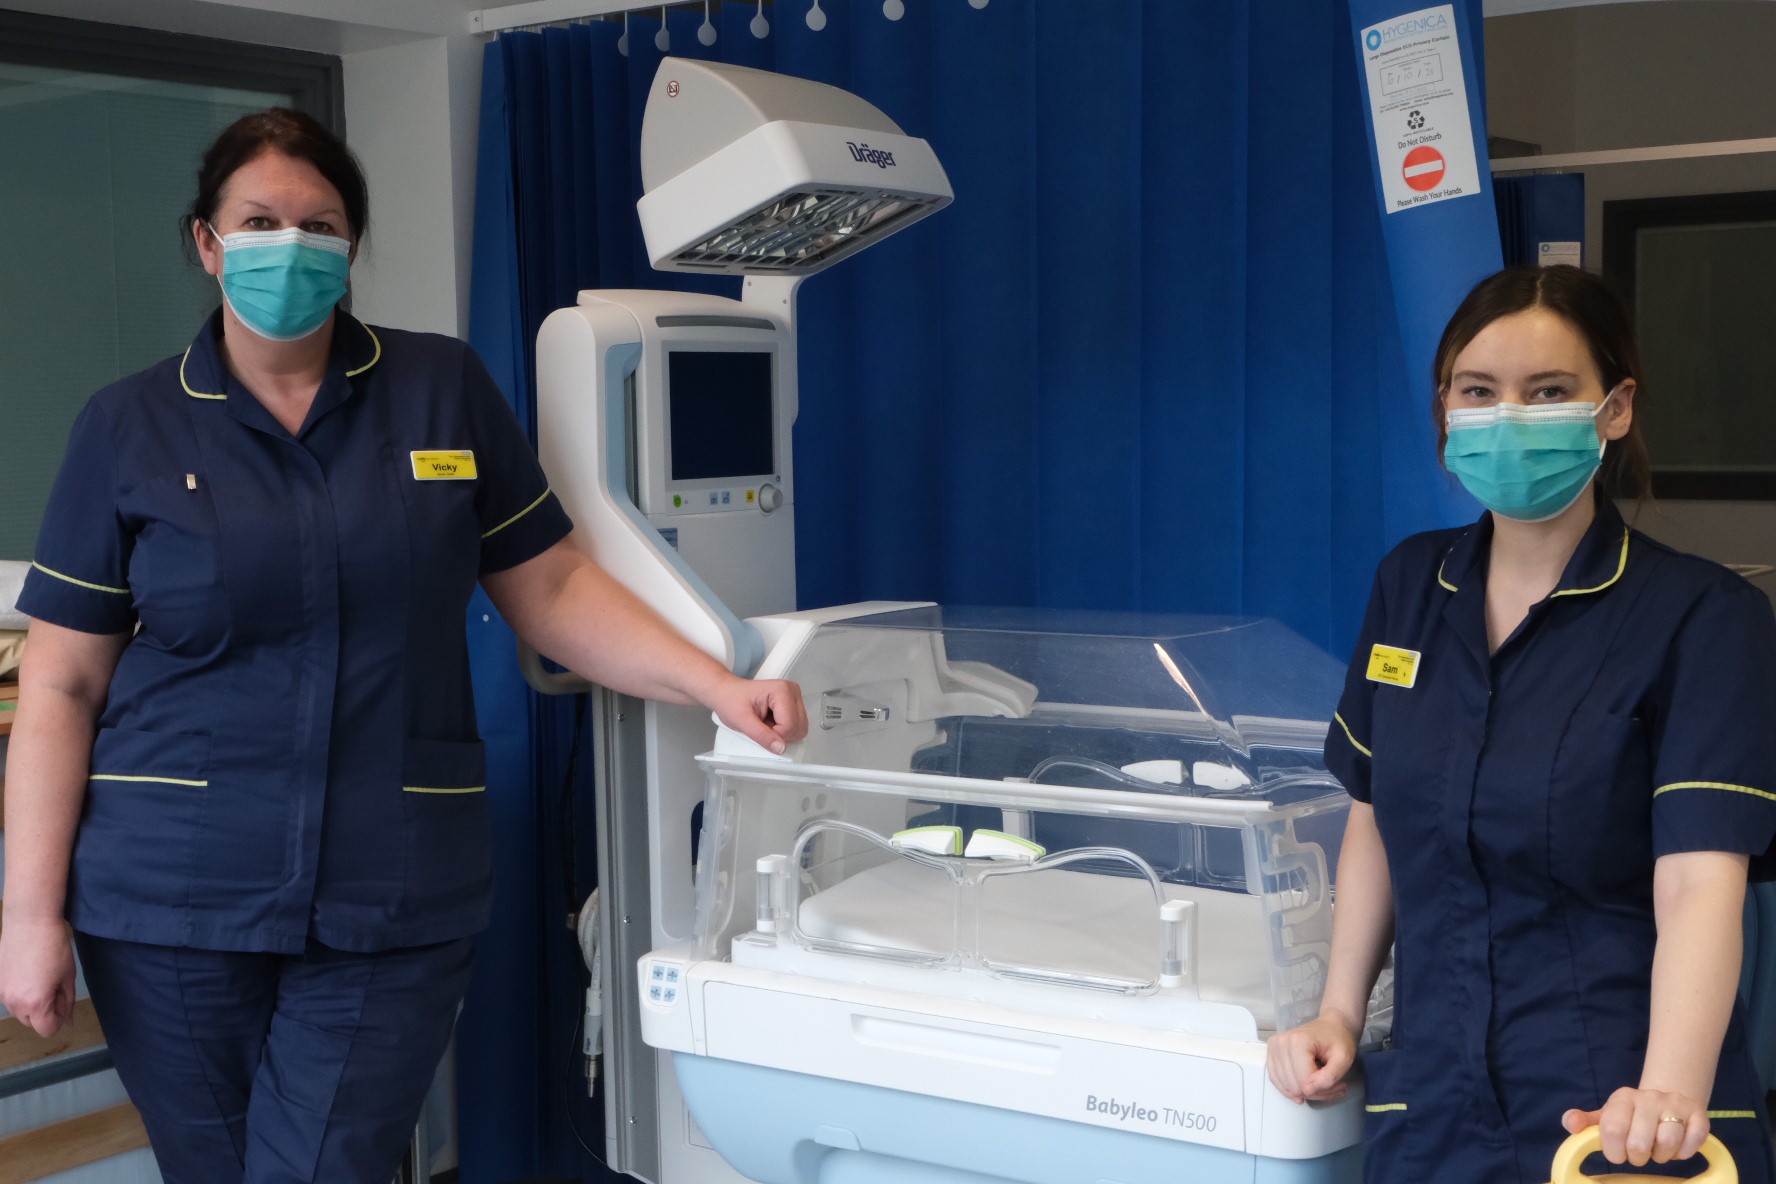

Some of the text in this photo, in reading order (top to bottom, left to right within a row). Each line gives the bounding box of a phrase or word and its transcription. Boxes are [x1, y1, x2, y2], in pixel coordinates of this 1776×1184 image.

[1382, 14, 1448, 40] HYGENICA
[1398, 132, 1442, 150] Do Not Disturb
[846, 141, 896, 169] Dräger
[1397, 186, 1463, 208] Please Wash Your Hands
[432, 463, 458, 473] Vicky
[1382, 662, 1399, 675] Sam
[1086, 1094, 1217, 1132] Babyleo TN500
